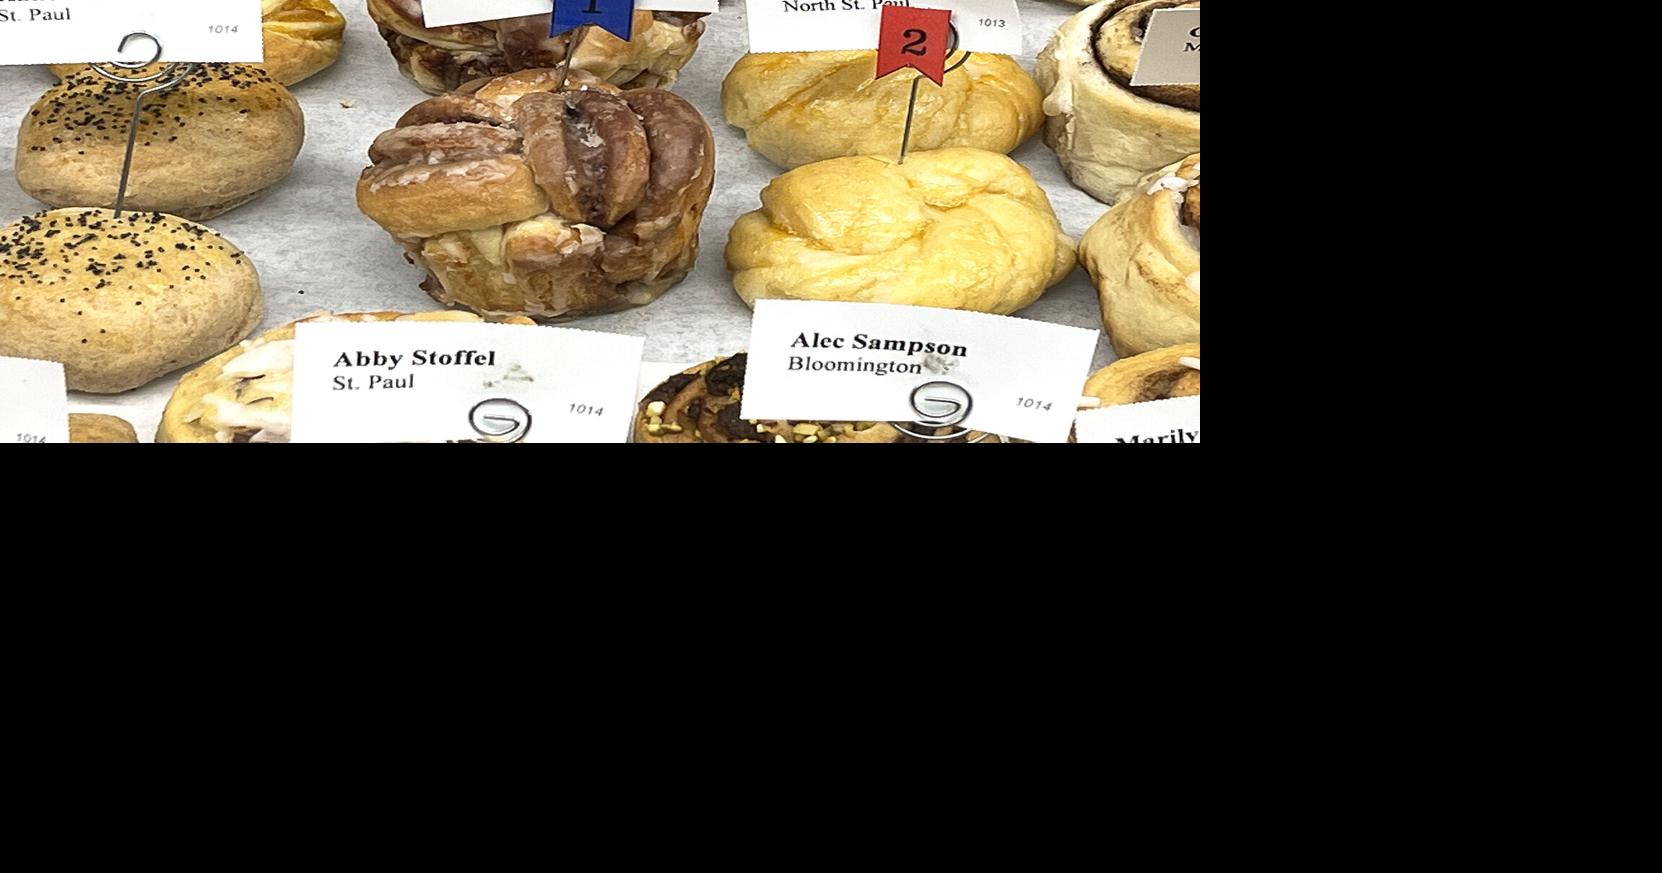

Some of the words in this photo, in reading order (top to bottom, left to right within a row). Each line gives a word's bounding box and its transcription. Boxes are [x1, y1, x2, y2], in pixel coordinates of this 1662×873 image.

[29, 7, 71, 21] Paul
[782, 0, 836, 12] North
[842, 0, 865, 10] St.
[208, 24, 239, 34] 1014
[978, 17, 1006, 28] 1013
[901, 28, 927, 56] 2
[790, 332, 845, 349] Alec
[852, 333, 967, 357] Sampson
[333, 351, 402, 370] Abby
[412, 350, 496, 366] Stoffel
[788, 356, 922, 376] Bloomington
[332, 375, 361, 391] St.
[368, 373, 415, 390] Paul
[569, 403, 604, 416] 1014
[1017, 396, 1053, 412] 1014
